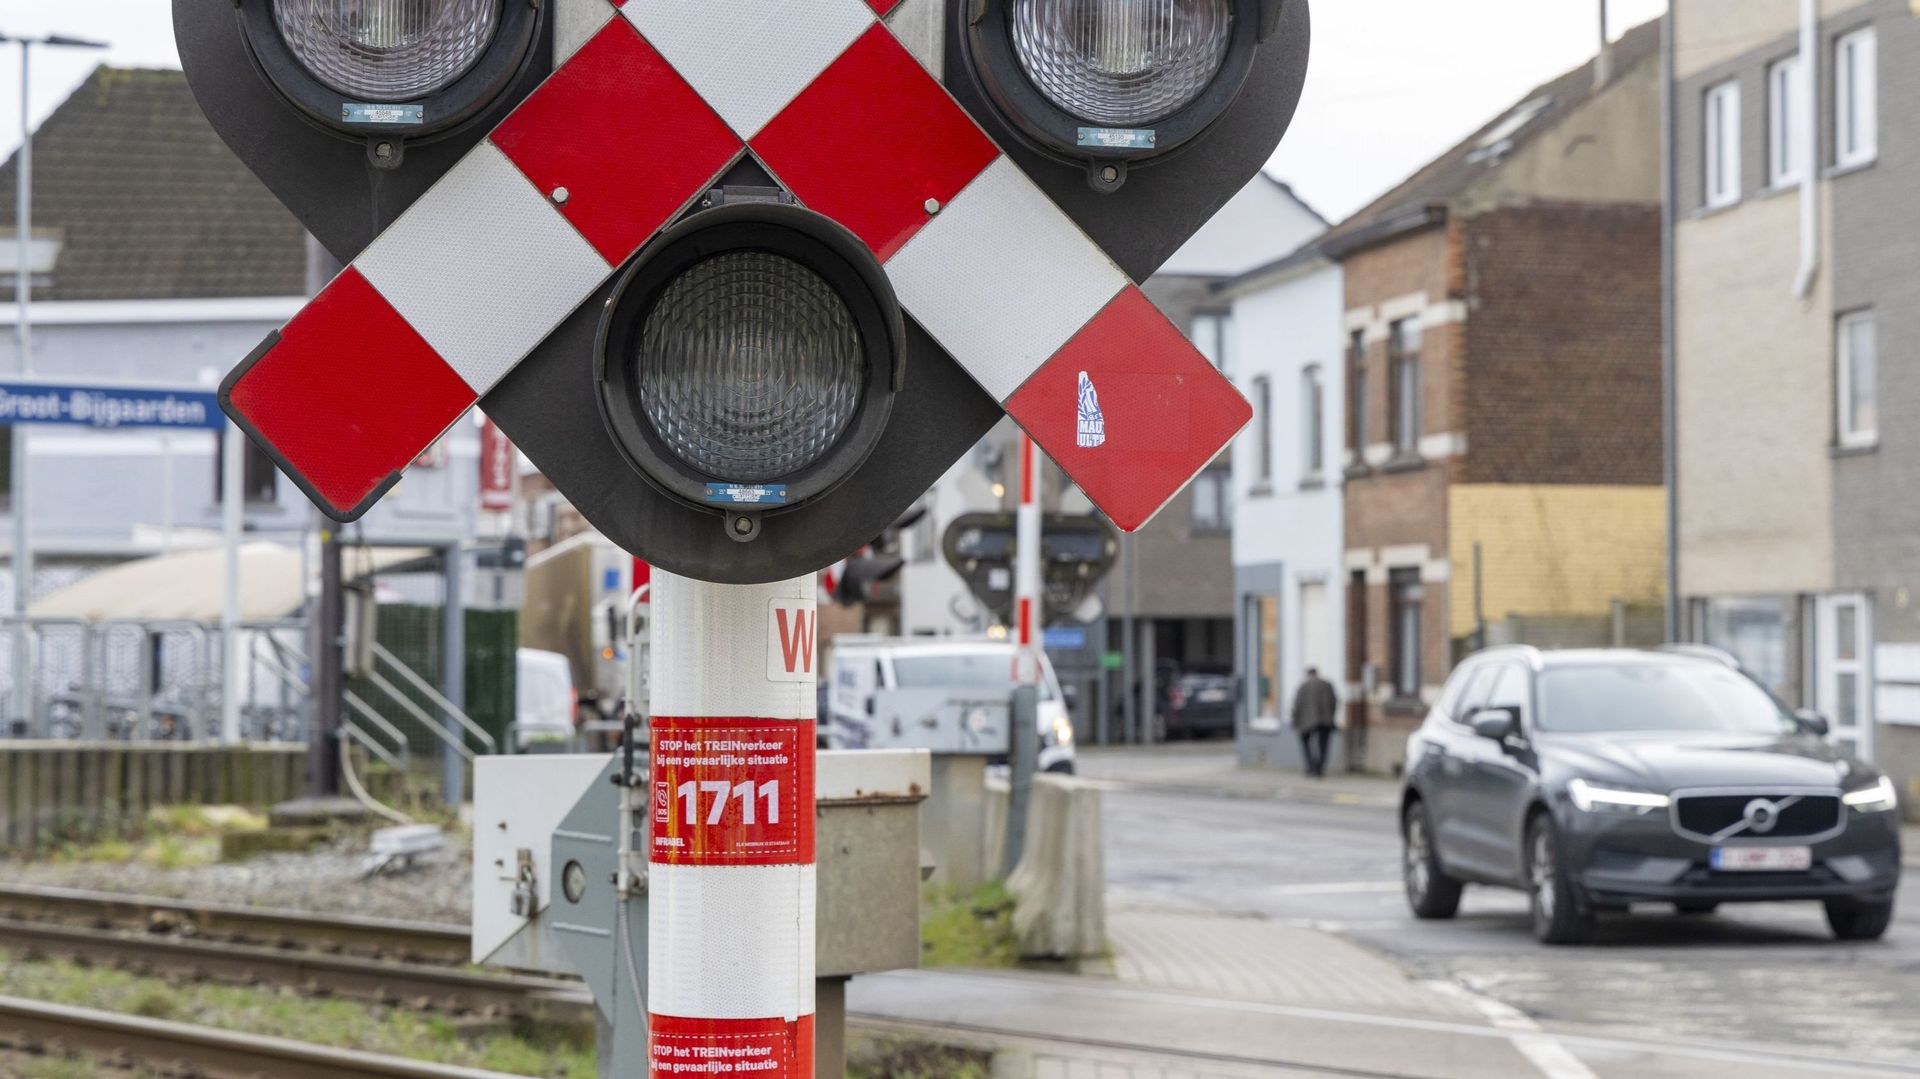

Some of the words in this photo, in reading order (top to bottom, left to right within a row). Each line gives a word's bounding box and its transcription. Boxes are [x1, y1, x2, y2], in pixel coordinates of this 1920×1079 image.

[775, 608, 815, 673] W
[659, 740, 683, 751] STOP
[684, 740, 702, 751] het
[704, 740, 784, 751] TREINverkeer
[656, 754, 666, 767] bij
[665, 756, 682, 765] een
[683, 754, 746, 768] gevaarlijke
[747, 753, 789, 765] situatie
[677, 779, 779, 825] 1711
[653, 1044, 672, 1056] STOP
[673, 1046, 690, 1058] het
[691, 1045, 772, 1058] TREINverkeer
[658, 1061, 672, 1071] een
[673, 1060, 733, 1074] gevaarlijke
[734, 1058, 778, 1072] situatie
